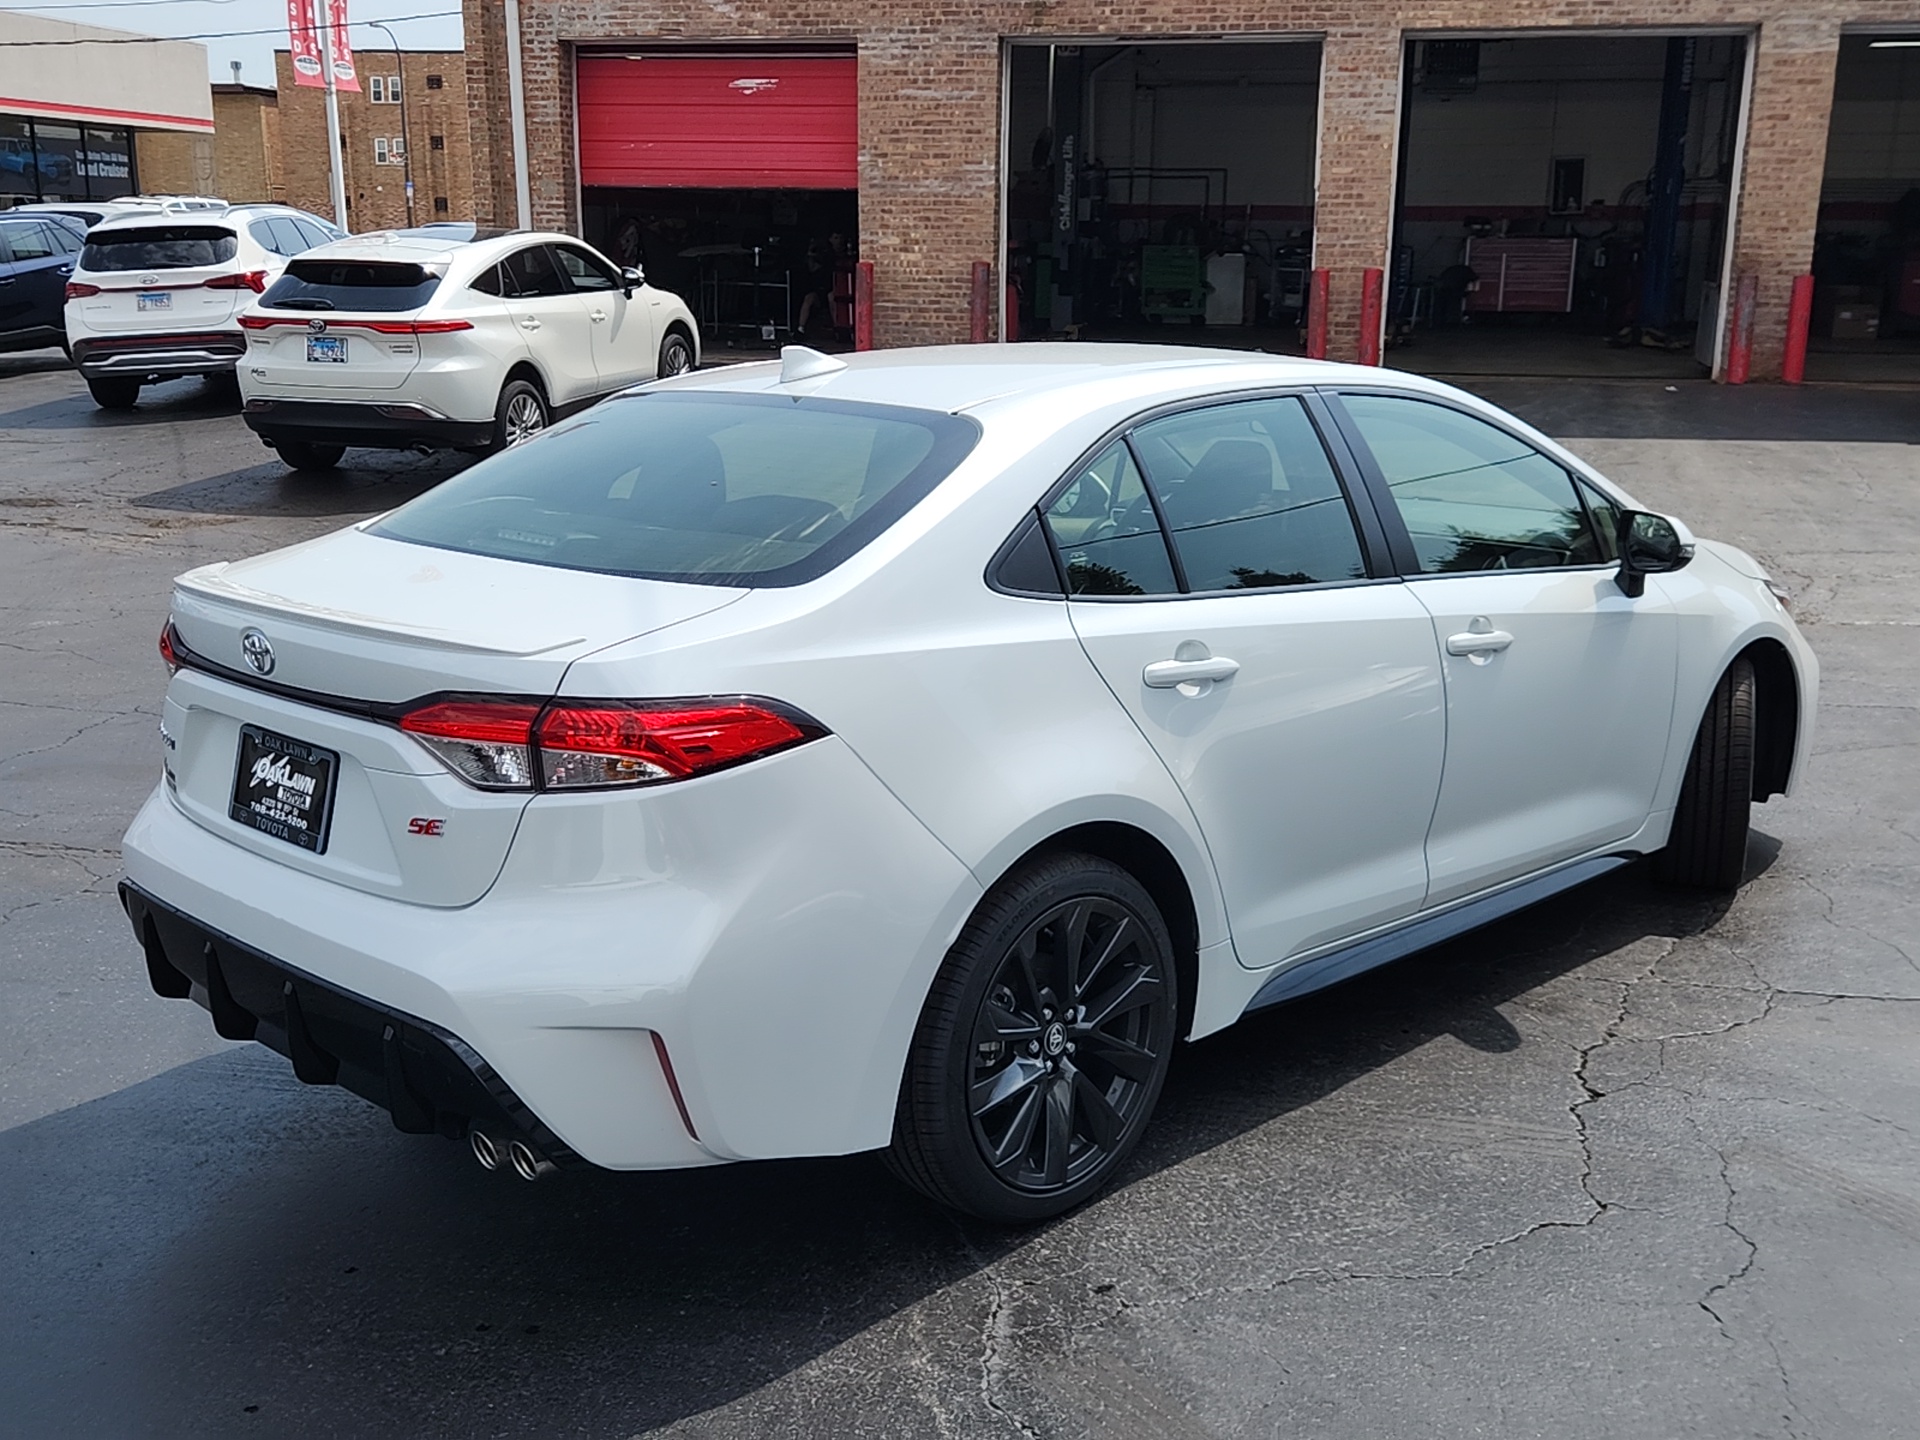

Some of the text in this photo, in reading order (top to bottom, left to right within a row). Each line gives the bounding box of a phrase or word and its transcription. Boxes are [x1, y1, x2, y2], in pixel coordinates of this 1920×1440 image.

[76, 161, 129, 178] Land Cruiser
[264, 736, 308, 759] OAK LAWN
[250, 801, 308, 830] 708-423-5200
[256, 815, 289, 839] TOYOTA
[407, 817, 447, 838] SE
